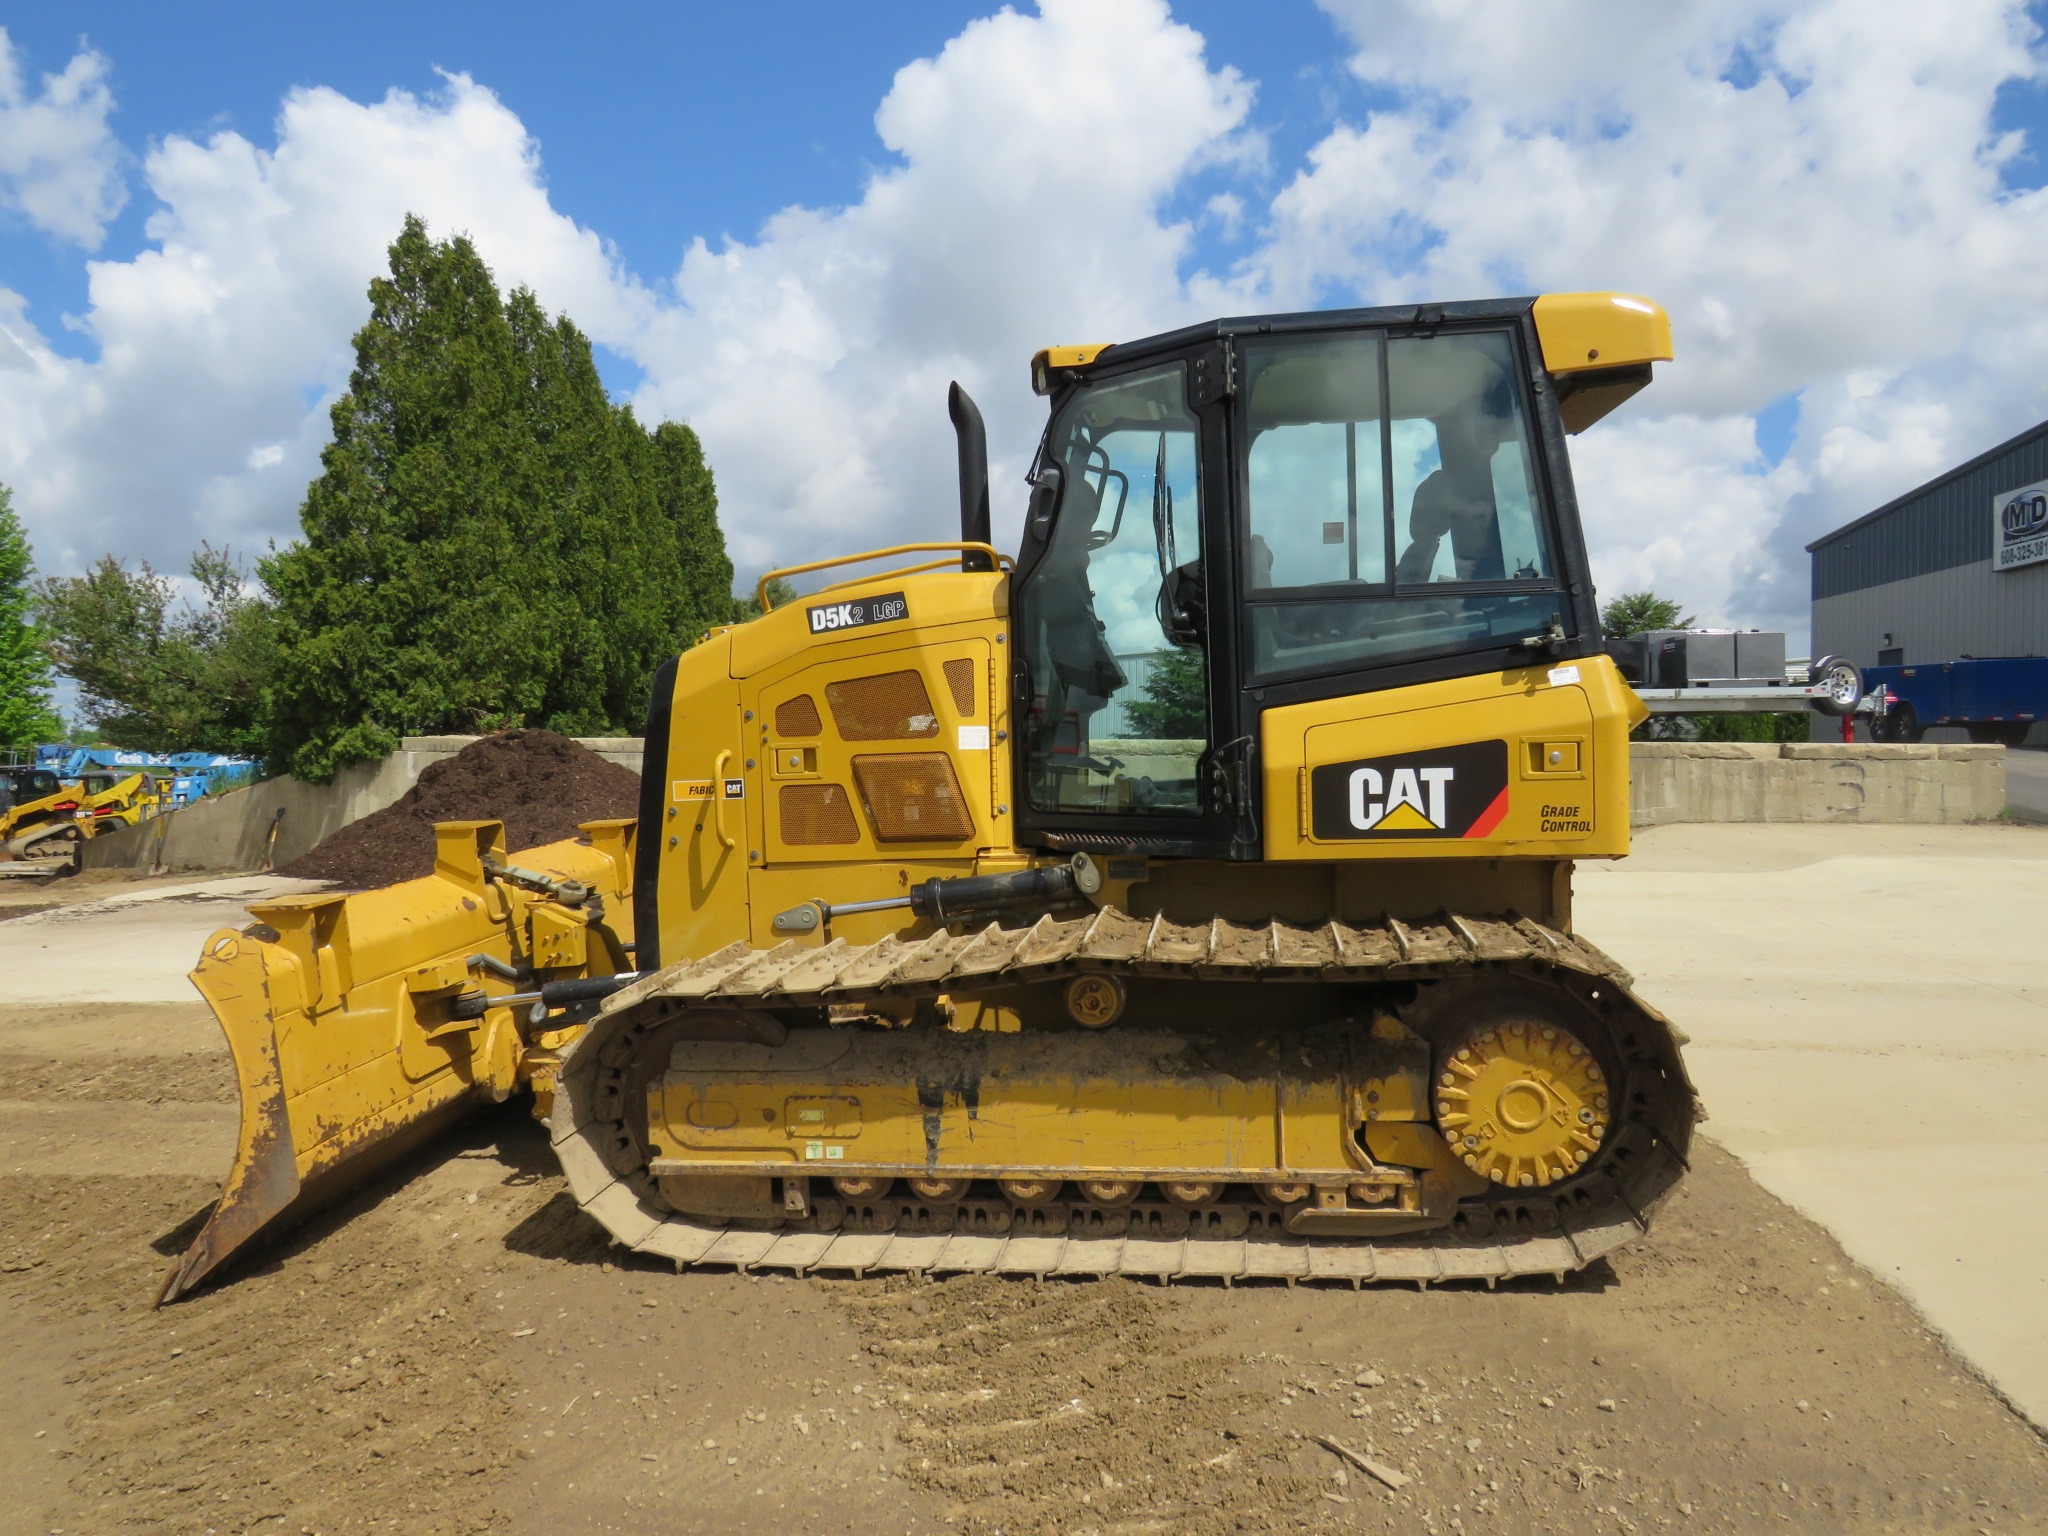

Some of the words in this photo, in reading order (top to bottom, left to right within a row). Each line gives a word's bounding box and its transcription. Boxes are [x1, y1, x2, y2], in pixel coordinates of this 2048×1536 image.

[811, 604, 864, 631] D5K2
[873, 600, 905, 621] LGP
[688, 785, 715, 795] FABIC
[726, 784, 742, 794] CAT
[1349, 767, 1454, 830] CAT
[1540, 804, 1580, 818] GRADE
[1540, 819, 1592, 833] CONTROL
